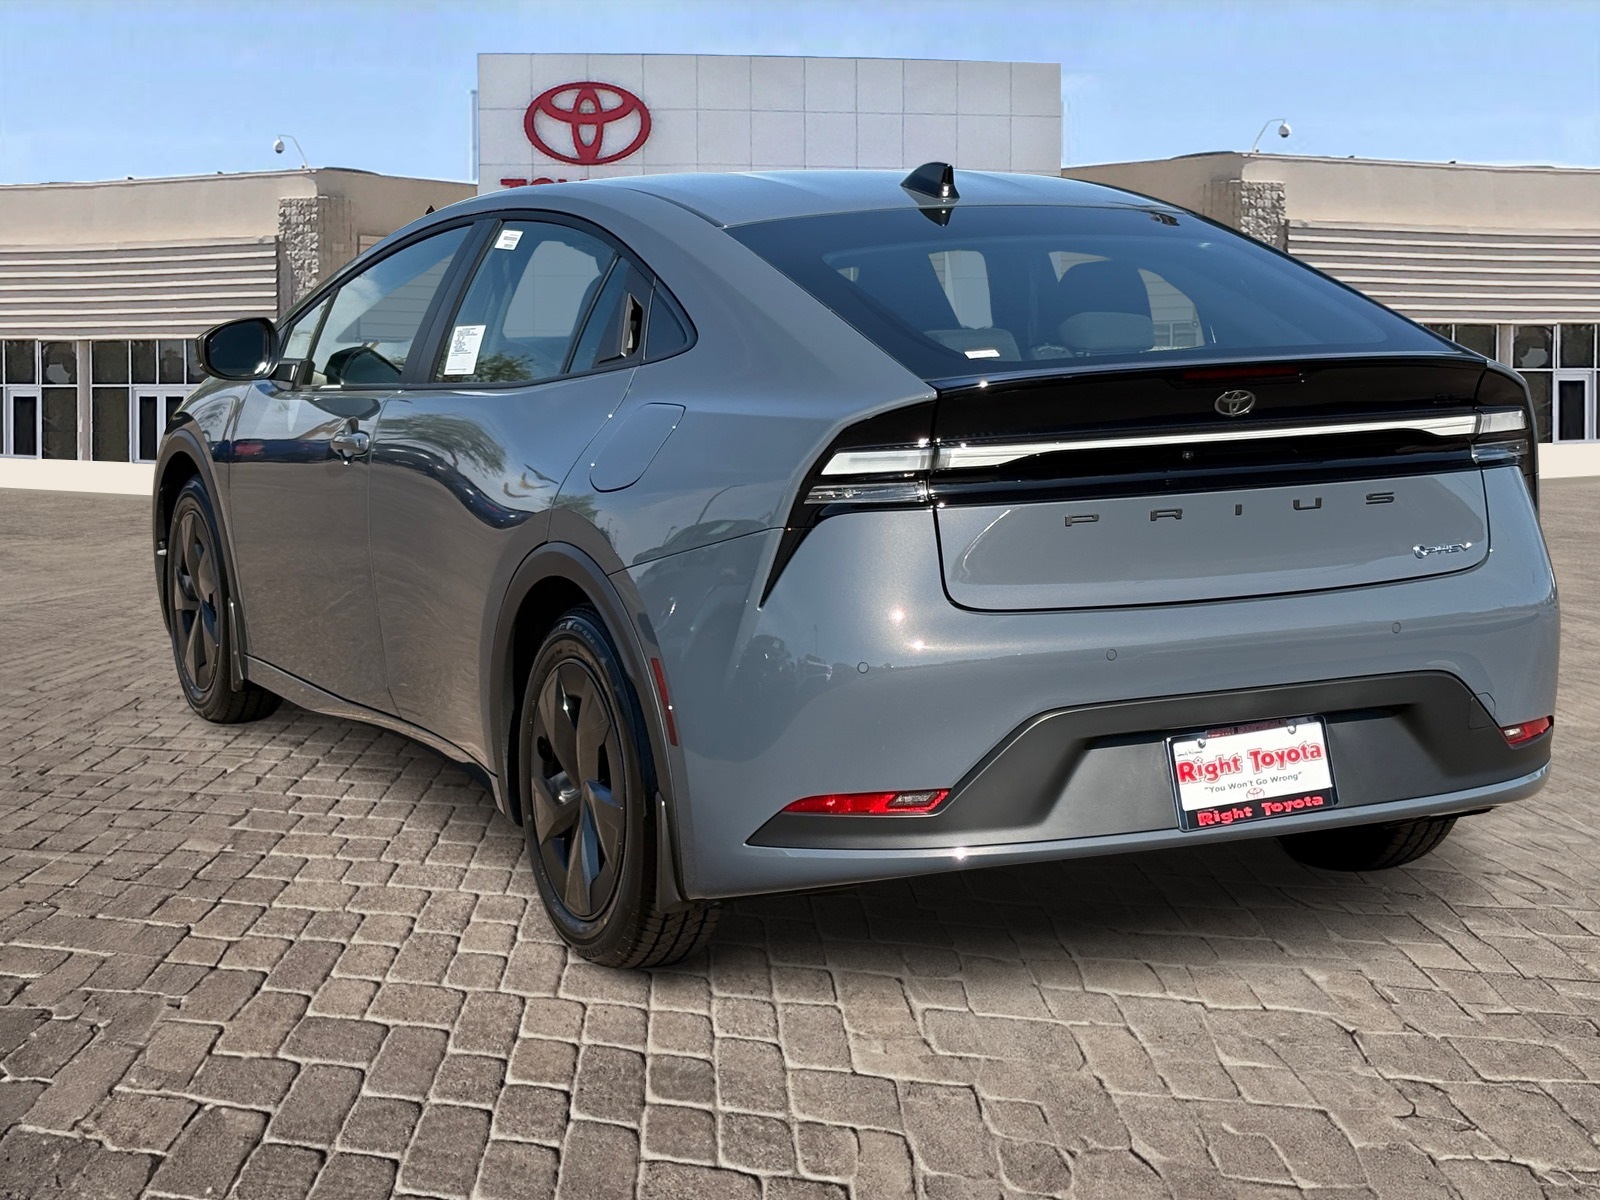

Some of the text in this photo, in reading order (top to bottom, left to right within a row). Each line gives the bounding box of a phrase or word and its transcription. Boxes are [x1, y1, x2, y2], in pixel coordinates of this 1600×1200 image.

[1065, 491, 1395, 527] PRIUS
[1177, 740, 1323, 784] Right Toyota
[1255, 778, 1268, 786] Go
[1197, 796, 1324, 826] Right Toyota
